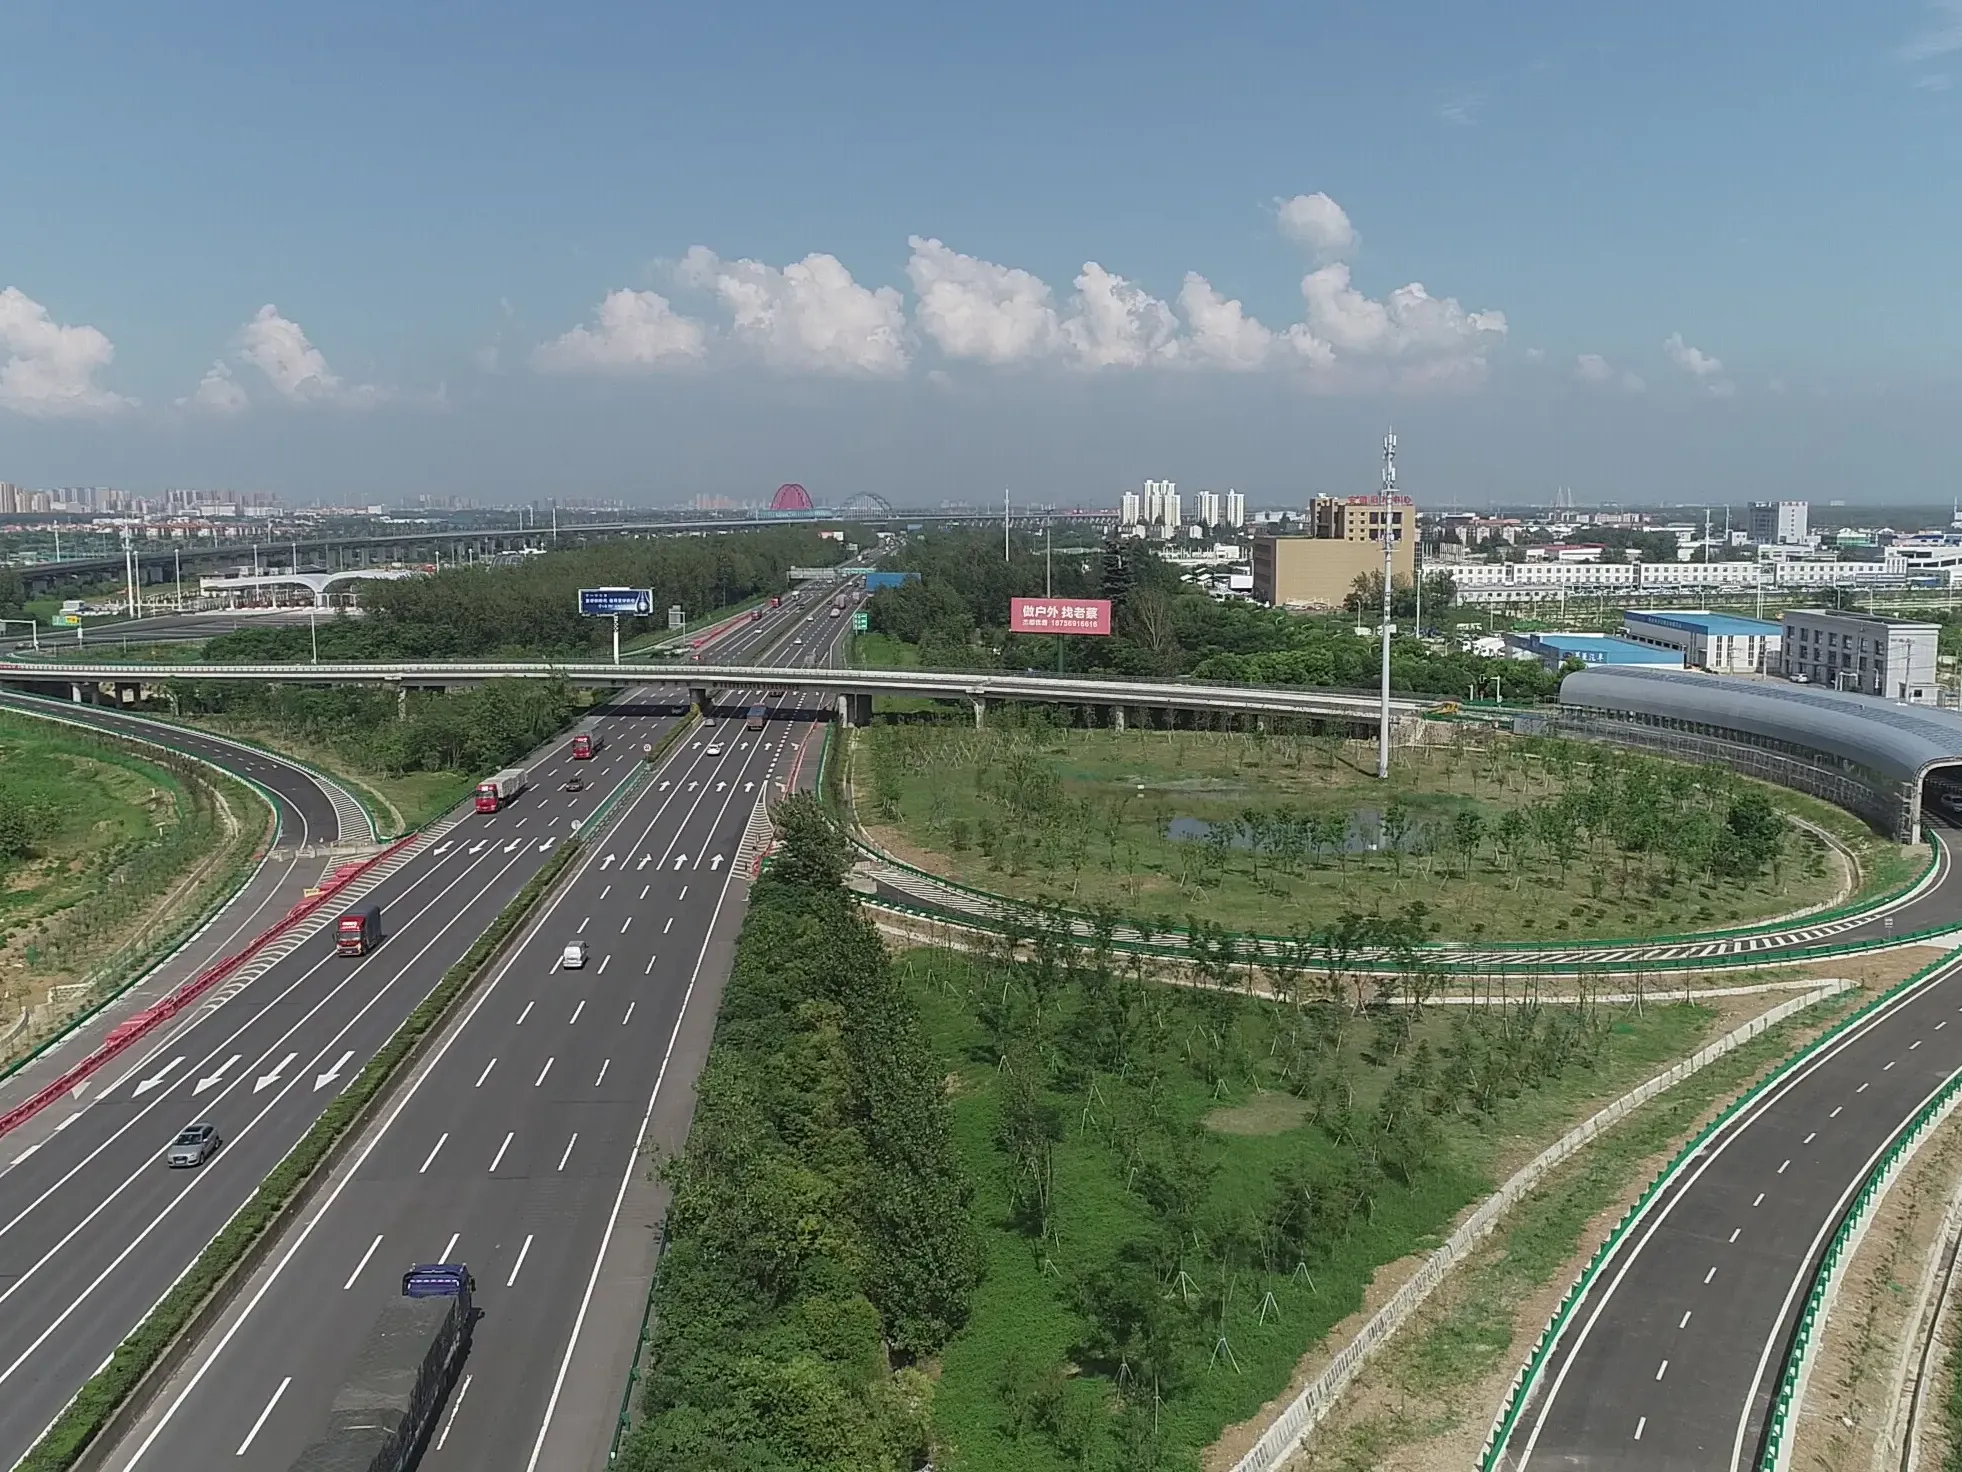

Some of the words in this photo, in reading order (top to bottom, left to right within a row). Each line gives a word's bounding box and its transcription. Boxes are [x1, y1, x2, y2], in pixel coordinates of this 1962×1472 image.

[1022, 605, 1059, 618] 做户外
[1061, 606, 1098, 619] 找老蔡
